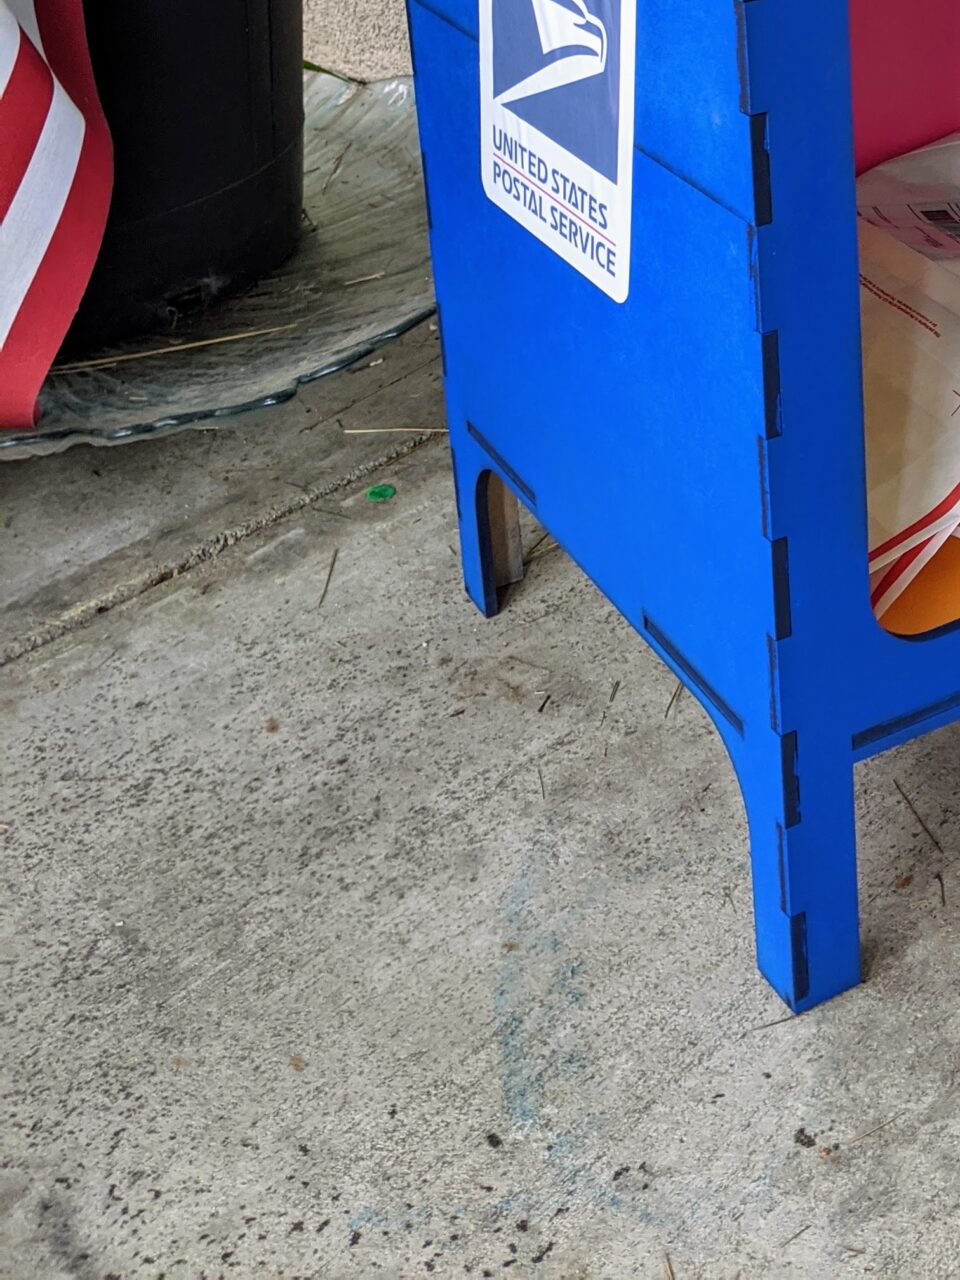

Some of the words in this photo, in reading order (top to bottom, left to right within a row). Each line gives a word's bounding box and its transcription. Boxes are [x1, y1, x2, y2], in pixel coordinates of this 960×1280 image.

[492, 124, 549, 183] UNITED
[551, 168, 608, 230] STATES
[493, 161, 548, 222] POSTAL
[549, 205, 617, 279] SERVICE
